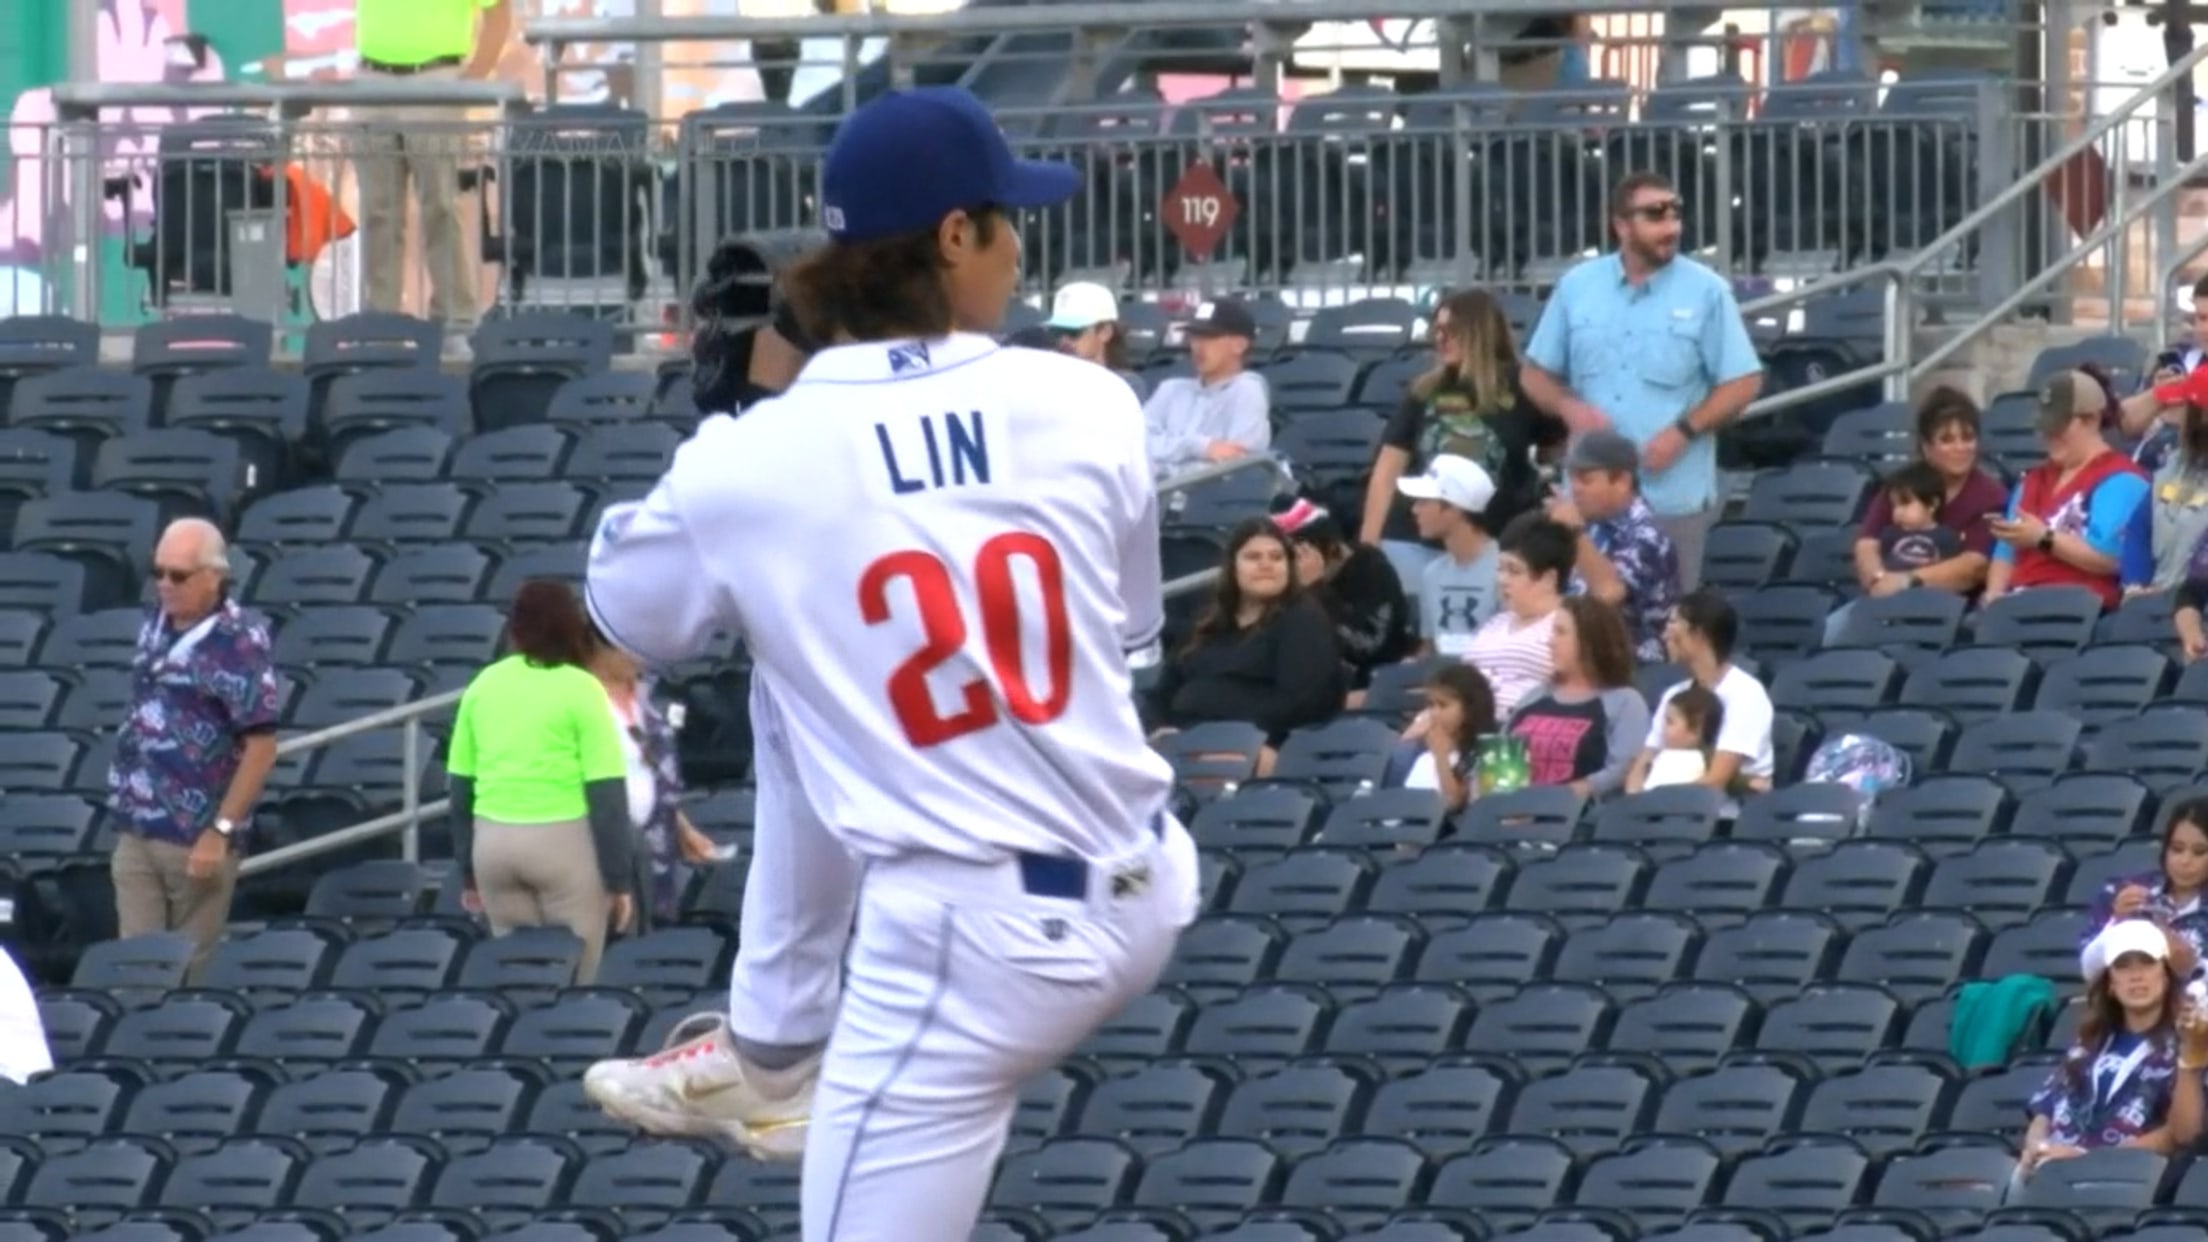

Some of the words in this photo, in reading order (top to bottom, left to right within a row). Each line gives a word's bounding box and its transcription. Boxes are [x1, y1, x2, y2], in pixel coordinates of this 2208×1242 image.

[1182, 196, 1220, 227] 119
[875, 411, 990, 493] LIN
[857, 531, 1071, 747] 20
